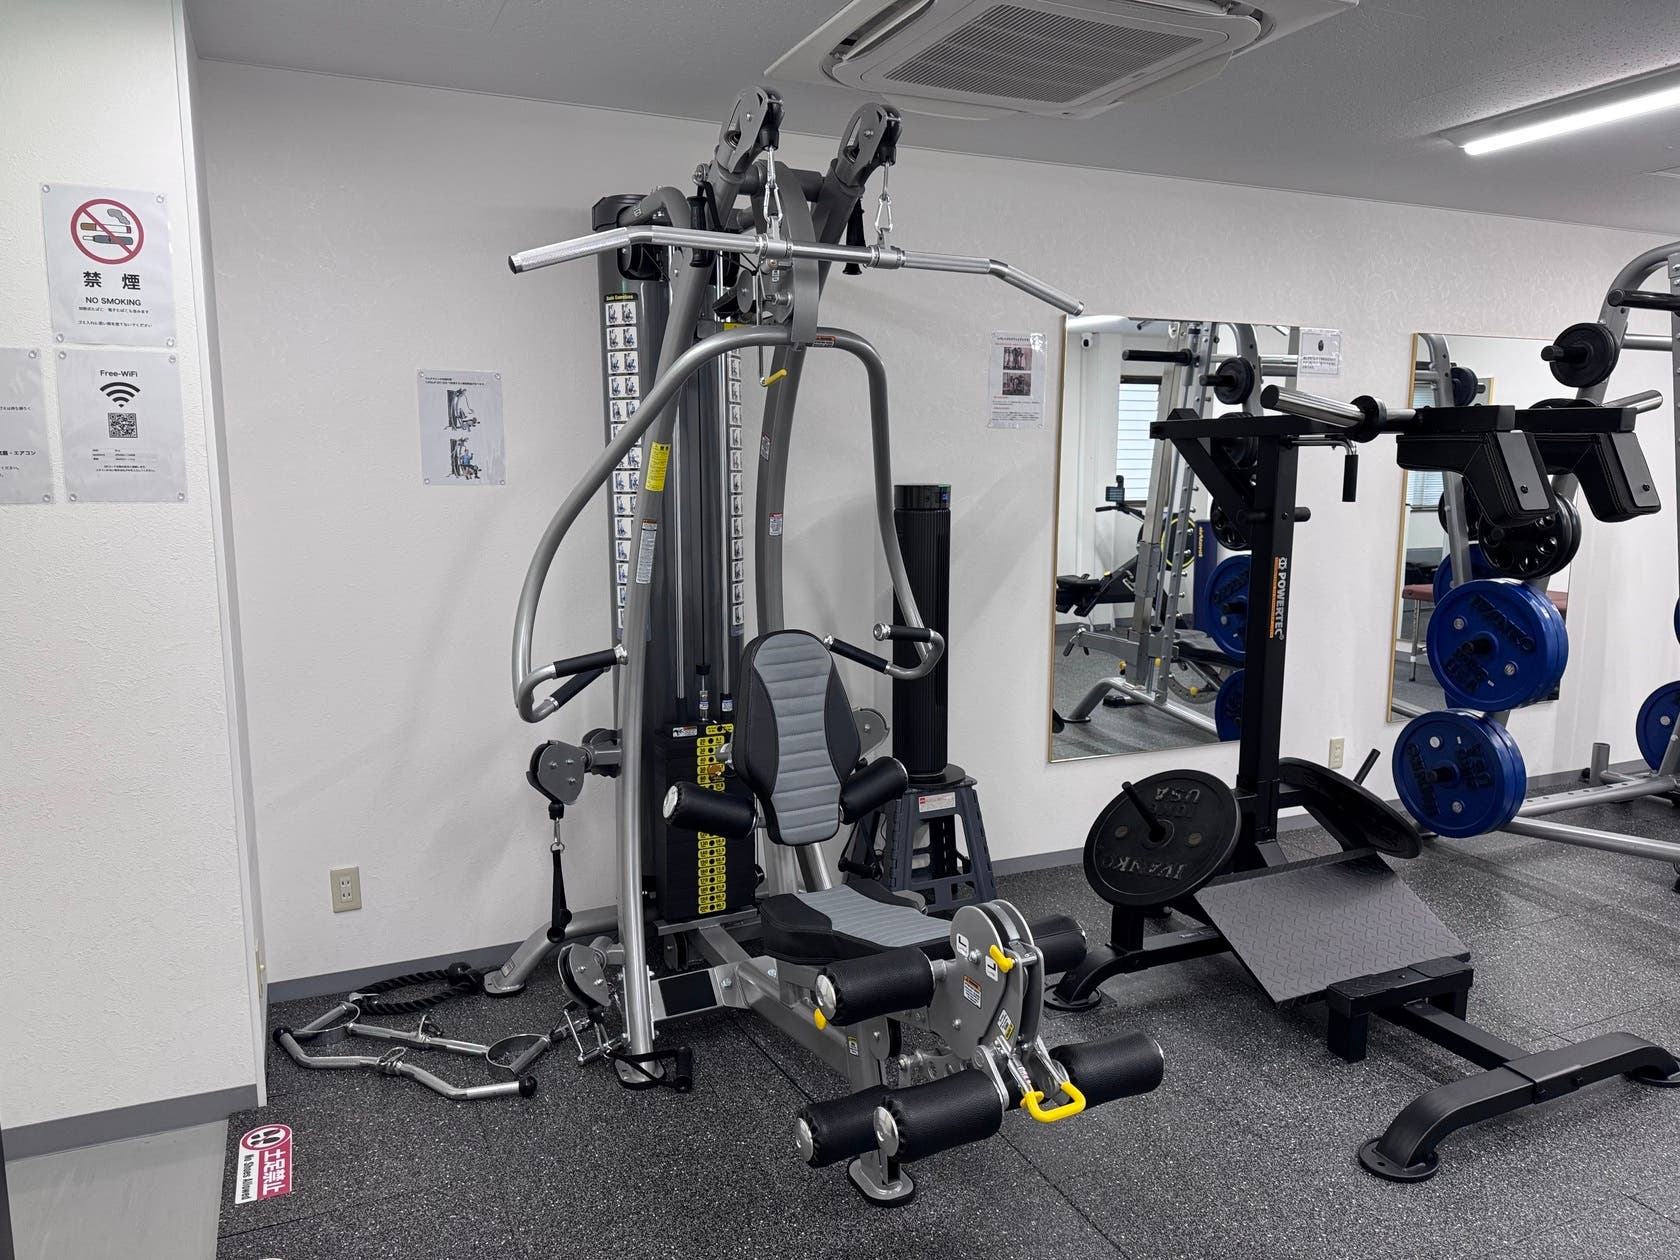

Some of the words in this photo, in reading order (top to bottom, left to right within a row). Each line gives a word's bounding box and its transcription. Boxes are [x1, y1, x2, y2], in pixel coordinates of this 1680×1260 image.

[83, 271, 102, 288] 禁
[121, 273, 141, 290] 煙
[101, 297, 142, 306] SMOKING
[99, 369, 138, 378] Free-WiFi
[1274, 572, 1287, 635] POWERTEC
[1154, 786, 1201, 804] USA
[242, 1161, 254, 1178] Shoes
[263, 1149, 286, 1195] 土足禁止
[241, 1178, 253, 1201] Allowed
